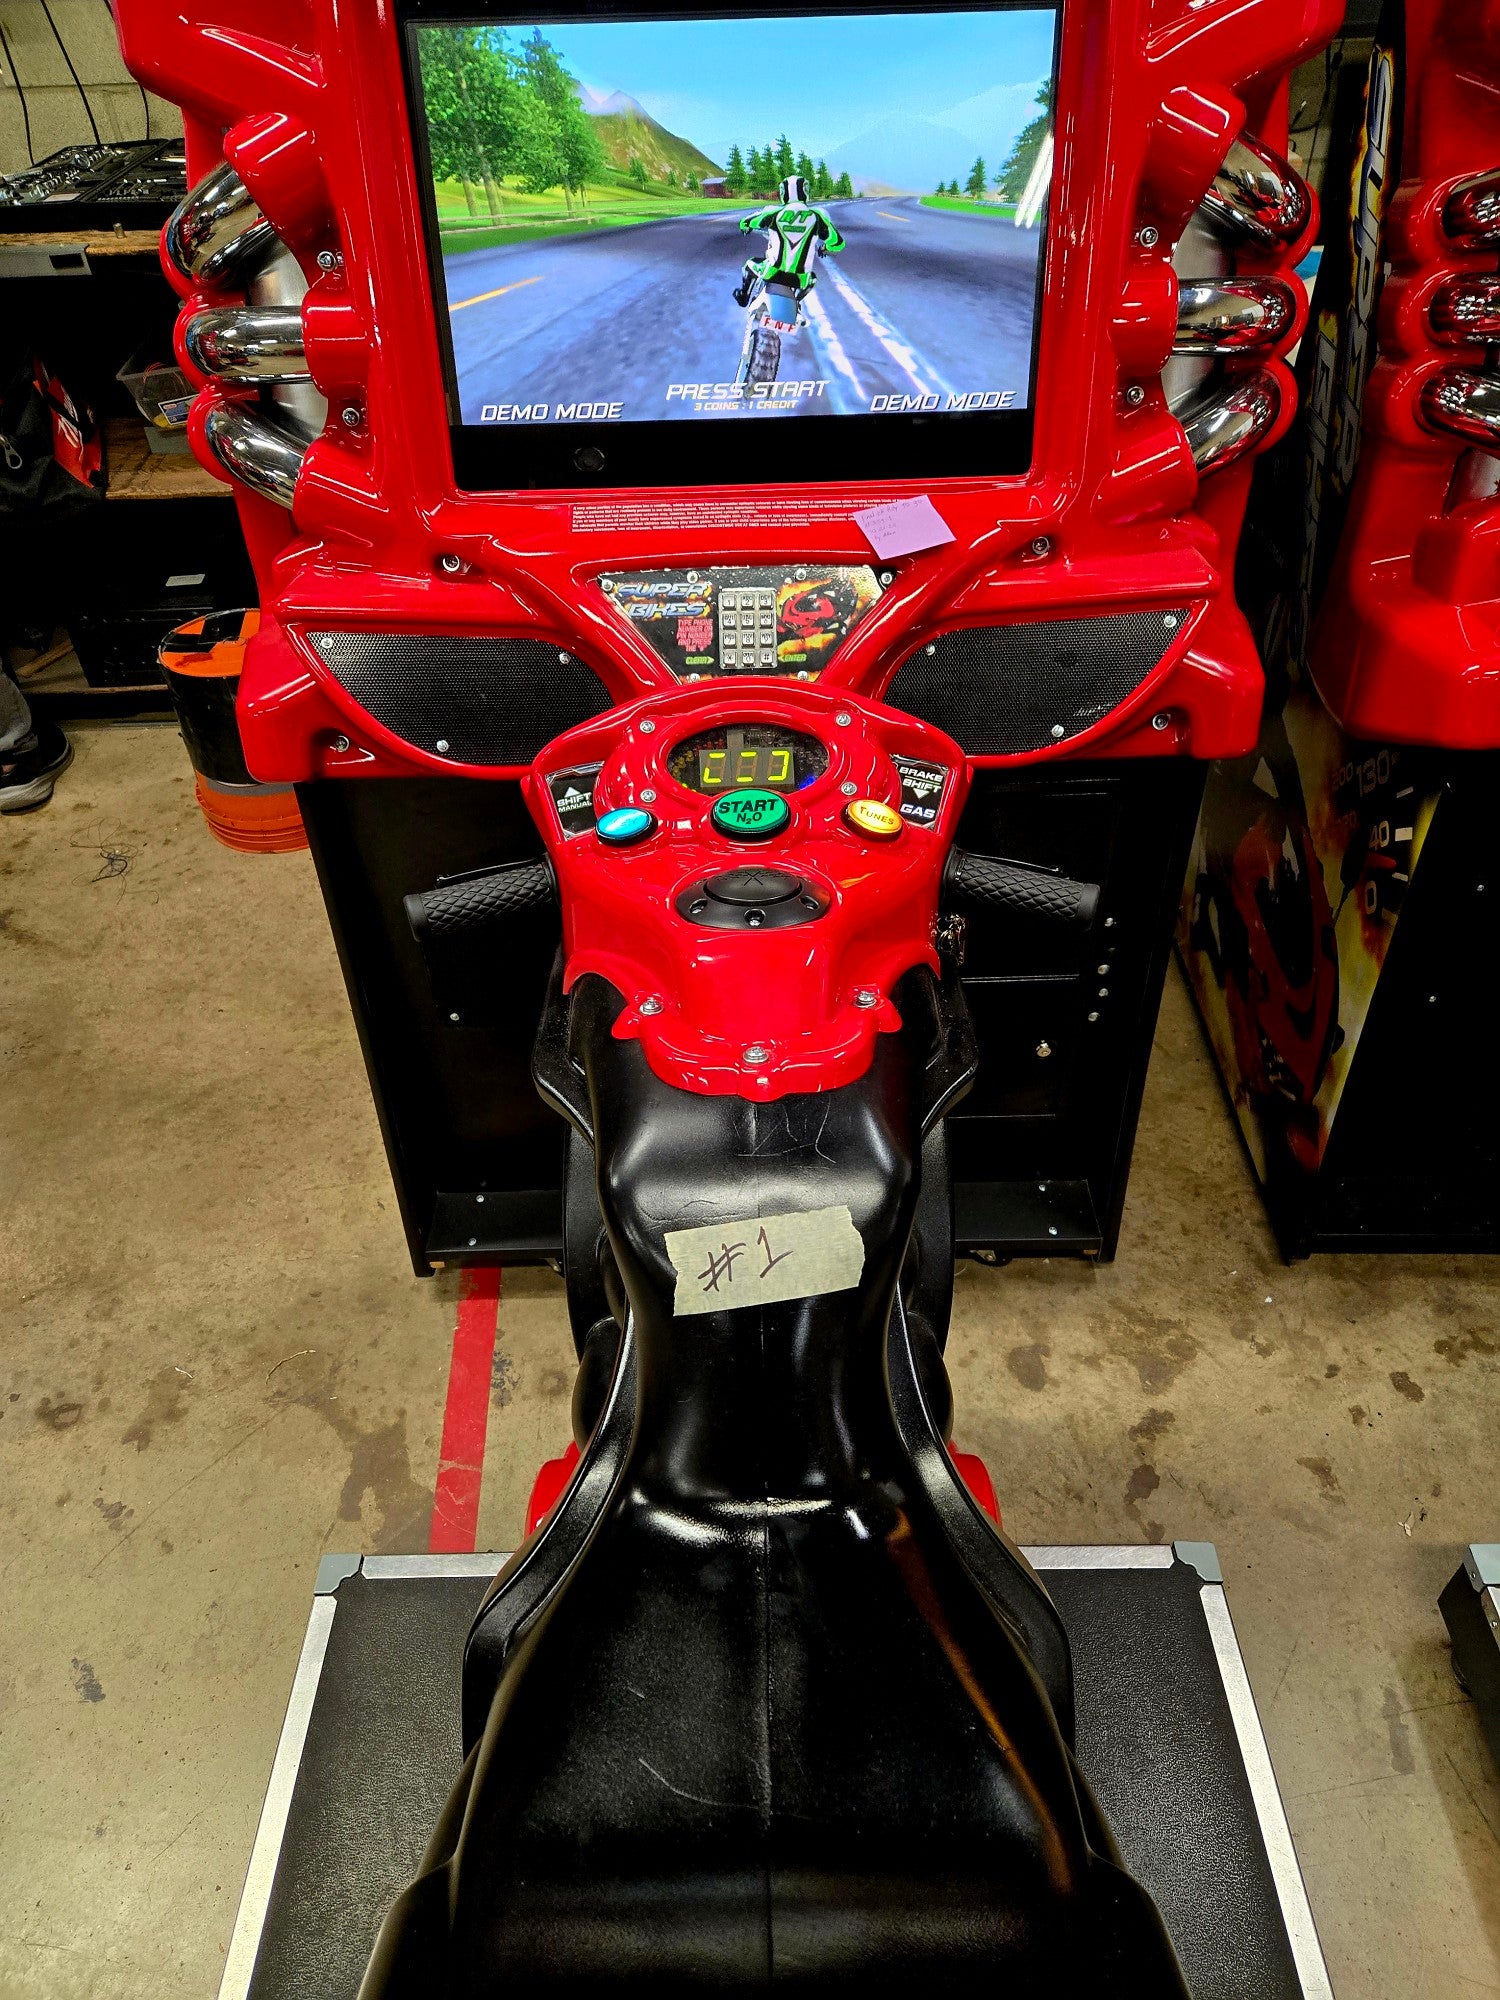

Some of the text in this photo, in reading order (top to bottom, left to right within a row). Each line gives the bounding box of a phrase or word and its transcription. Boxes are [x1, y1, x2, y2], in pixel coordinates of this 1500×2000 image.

[666, 380, 830, 400] PRESS START
[694, 402, 701, 411] 3
[704, 401, 739, 411] COINS
[757, 400, 799, 410] CREDIT
[870, 390, 1017, 412] DEMO MODE
[481, 402, 624, 421] DEMO MODE
[618, 583, 708, 598] SUPER
[629, 602, 707, 619] BIKES
[693, 618, 713, 626] PHONE
[688, 631, 713, 639] NUMBER
[899, 766, 944, 782] BRAKE
[1356, 749, 1390, 798] 130
[902, 778, 942, 793] SHIFT
[557, 791, 592, 807] SHIFT
[558, 801, 593, 813] MANUAL
[718, 799, 778, 814] START
[860, 806, 894, 825] TUNES
[900, 803, 936, 819] GAS
[1369, 820, 1391, 851] 40
[1364, 880, 1378, 915] 0
